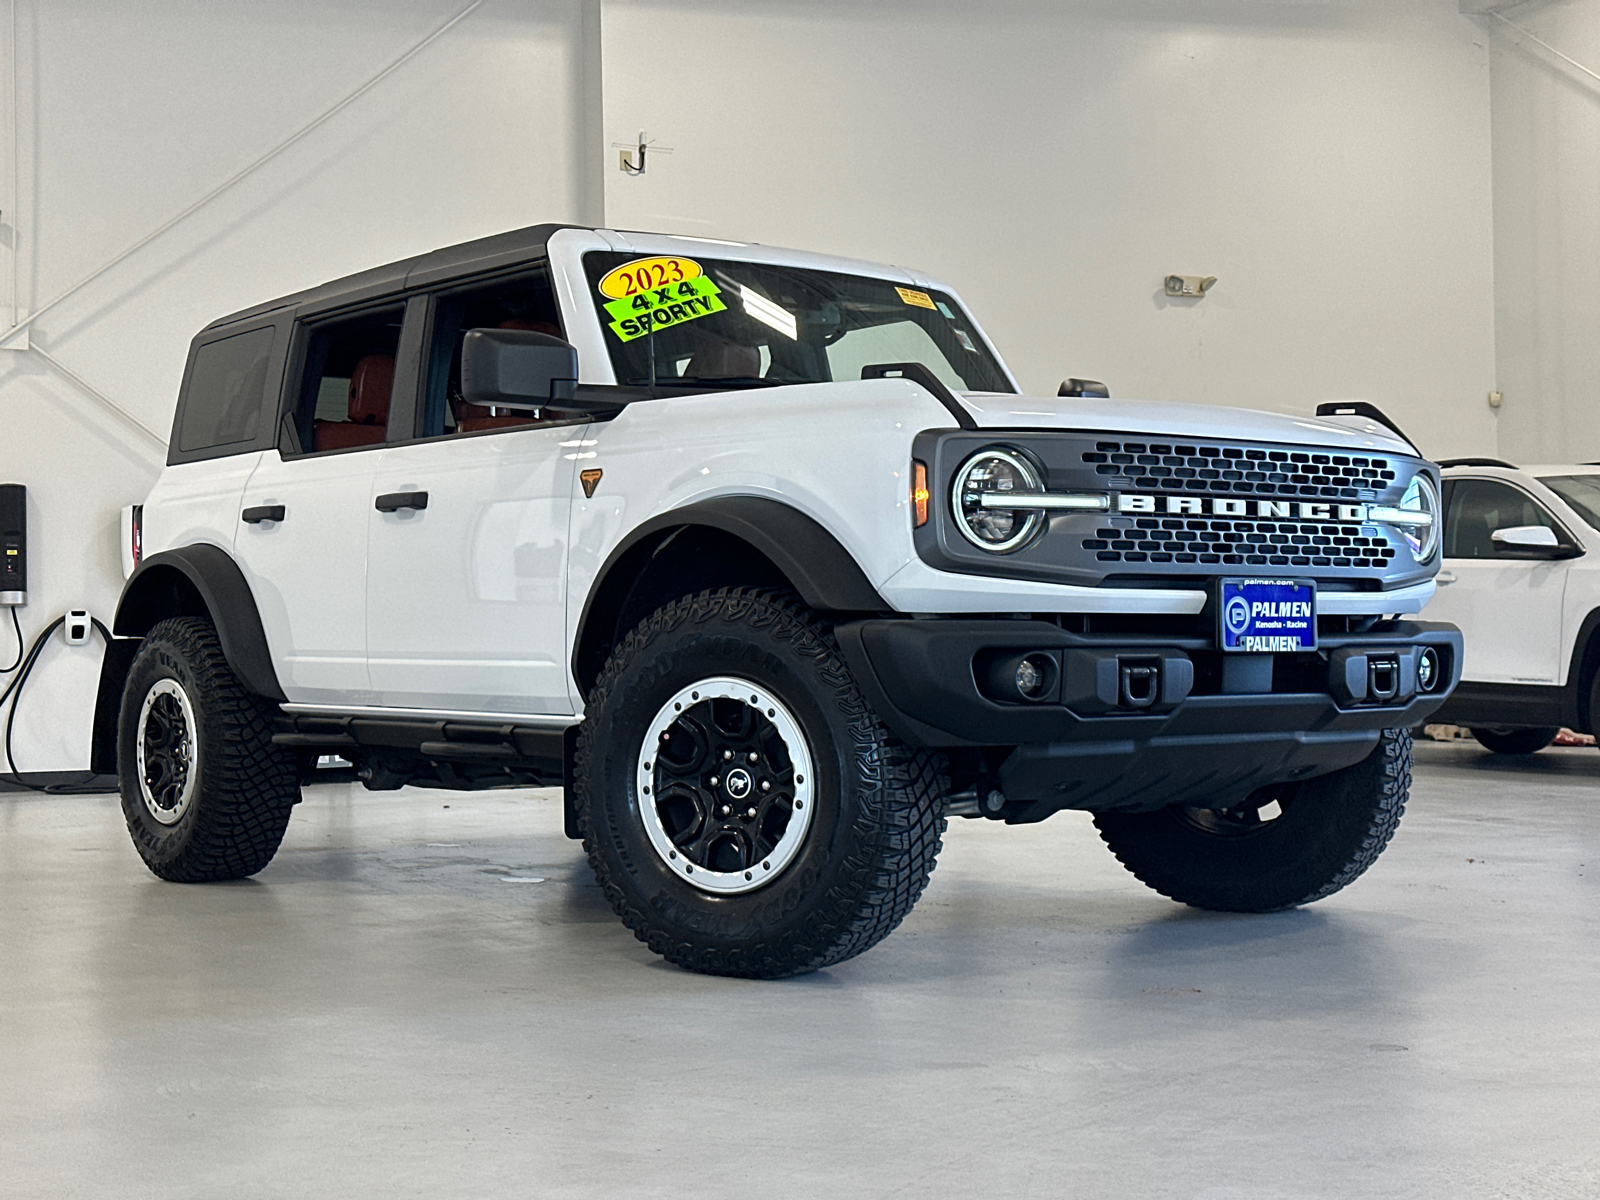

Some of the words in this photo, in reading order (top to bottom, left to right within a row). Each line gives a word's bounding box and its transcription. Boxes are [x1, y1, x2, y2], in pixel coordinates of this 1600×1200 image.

[620, 260, 684, 295] 2023
[632, 294, 652, 310] 4
[678, 282, 698, 297] 4
[620, 295, 713, 335] SPORTY
[1118, 494, 1367, 521] BRONCO
[1252, 602, 1311, 617] PALMEN
[1246, 636, 1296, 651] PALMEN
